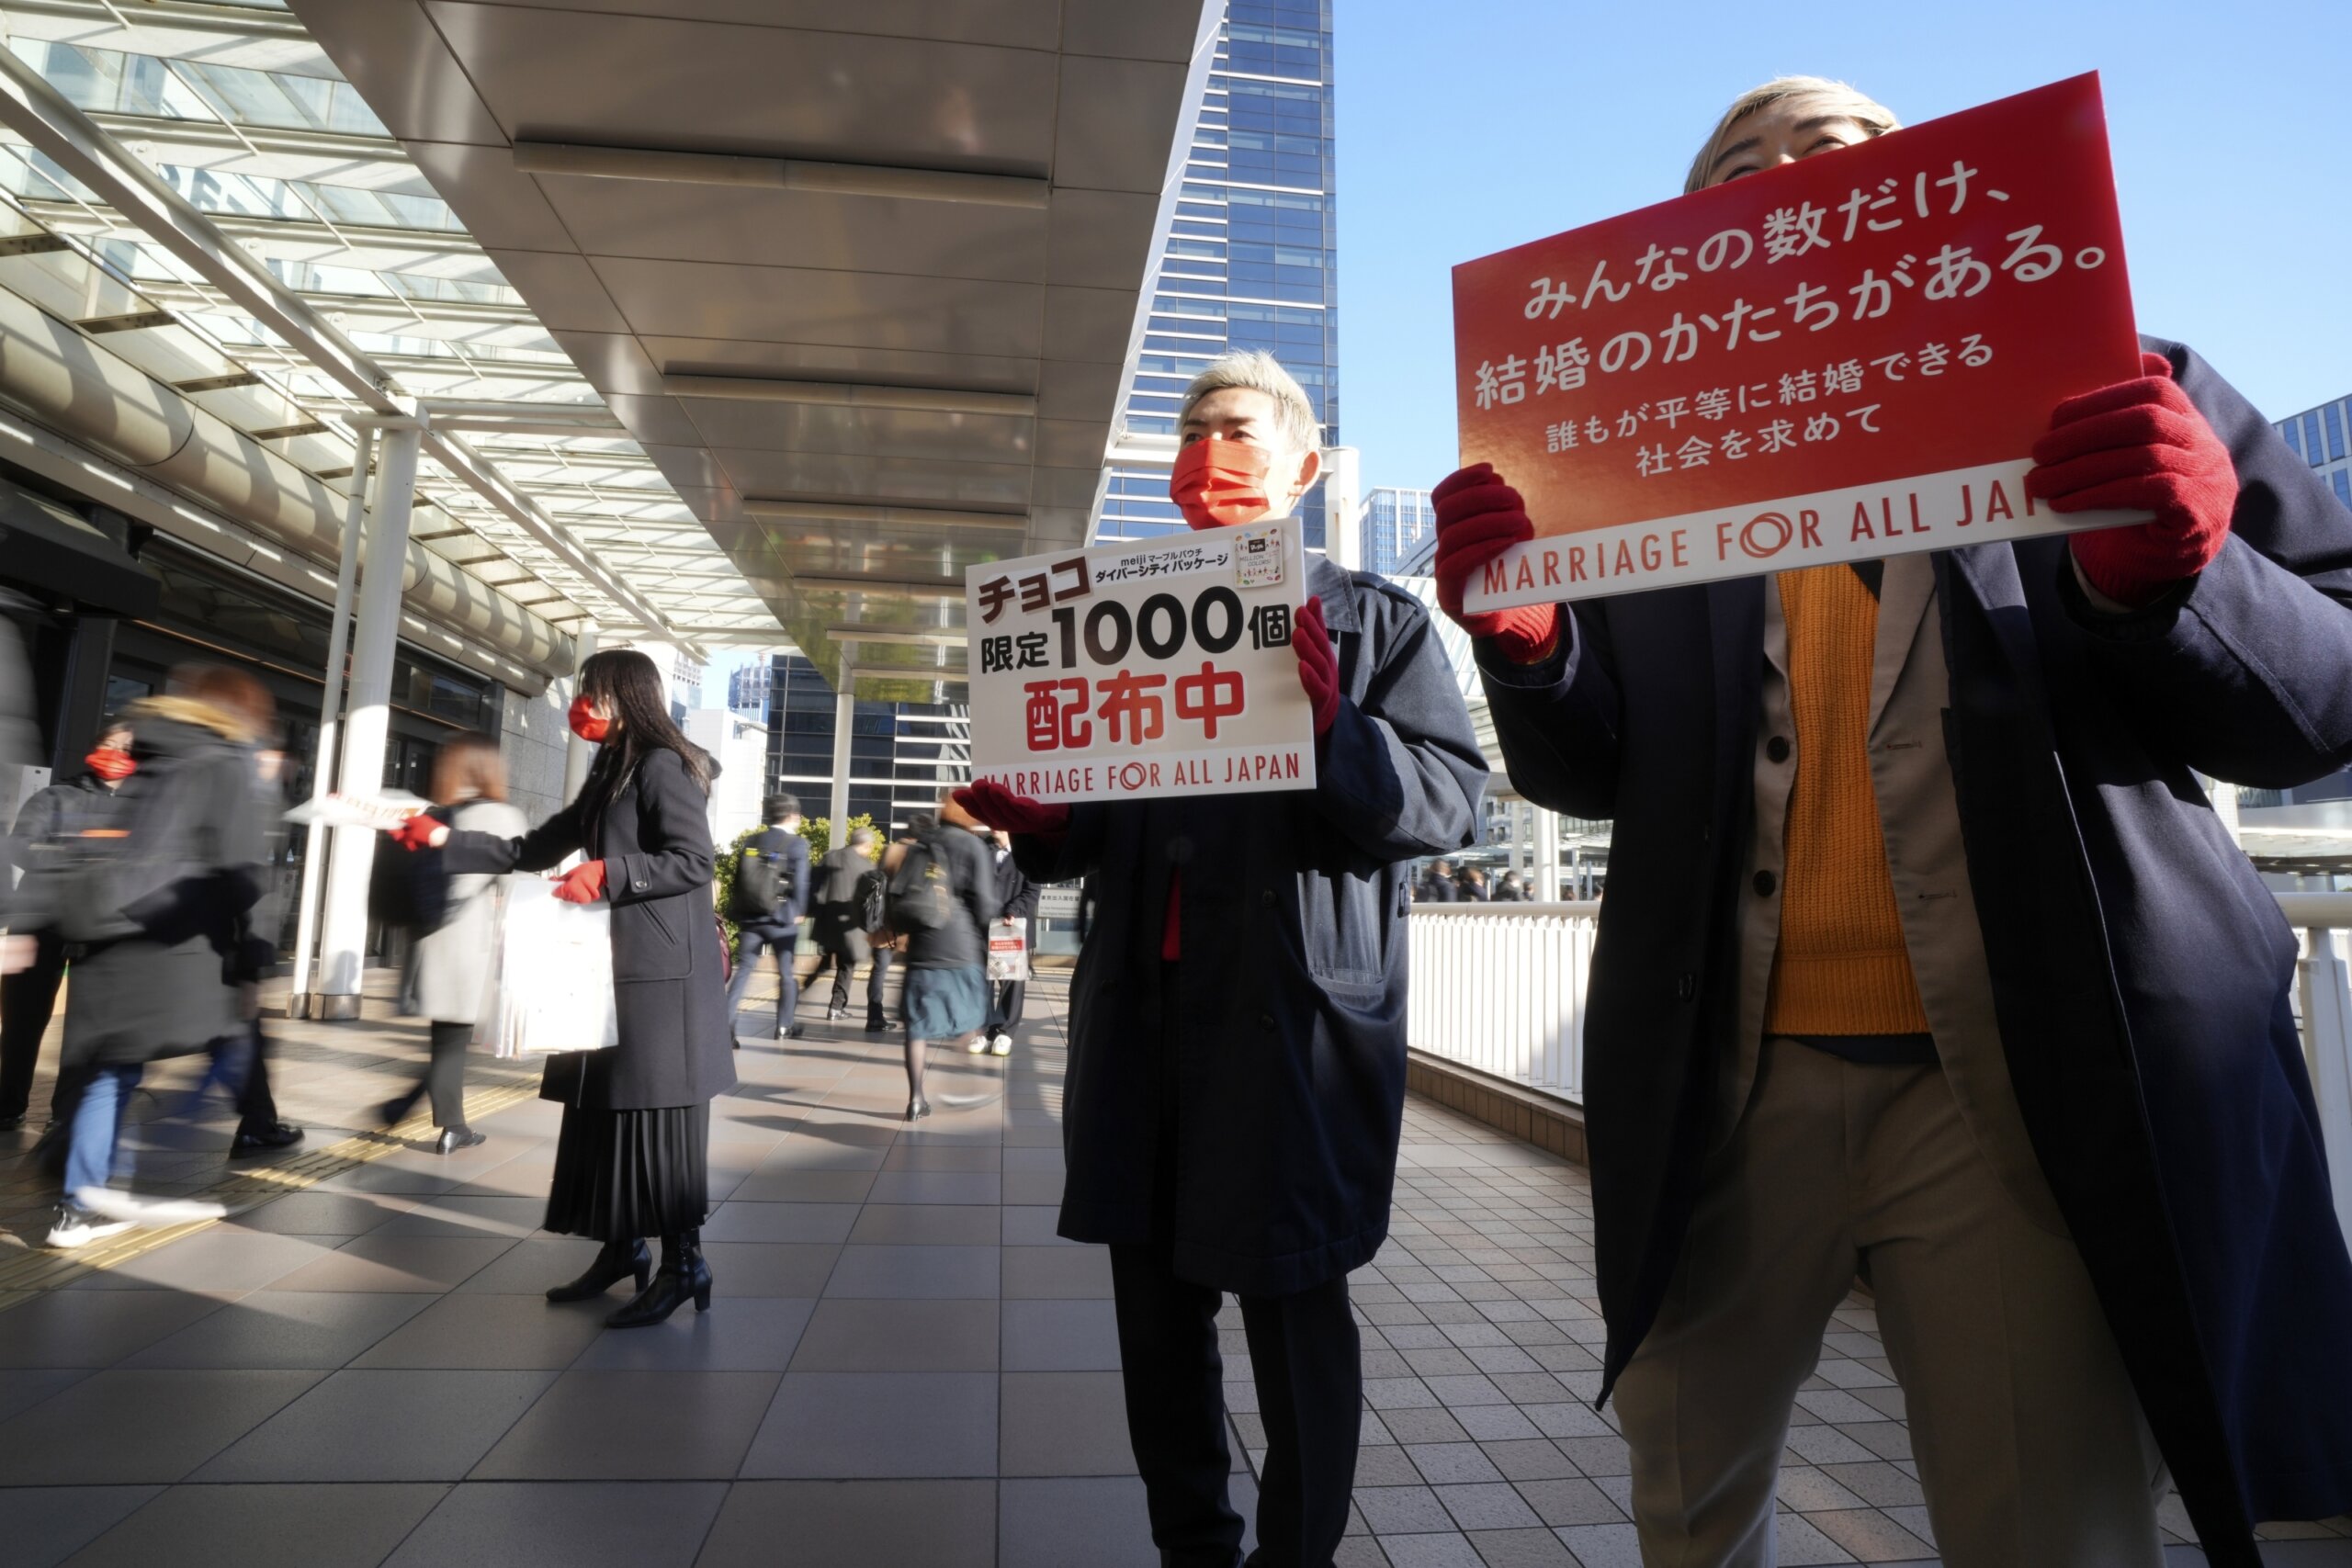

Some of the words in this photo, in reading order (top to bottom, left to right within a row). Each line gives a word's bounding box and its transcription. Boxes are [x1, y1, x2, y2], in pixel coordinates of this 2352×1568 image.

[1523, 160, 2010, 320] みんなの数だけ、
[1475, 224, 2107, 411] 結婚のかたちがある。
[1545, 333, 1994, 454] 誰もが平等に結婚できる
[1635, 403, 1883, 478] 社会を求めて
[1121, 554, 1147, 567] meiji
[1483, 529, 1690, 596] MARRIAGE
[1716, 509, 1824, 561] FOR
[1849, 491, 1932, 542] ALL
[1955, 475, 2035, 528] JA
[978, 556, 1091, 624] チョコ
[1023, 660, 1245, 752] 配布中
[1107, 761, 1161, 791] FOR
[1173, 759, 1213, 786] ALL
[1224, 752, 1300, 783] JAPAN
